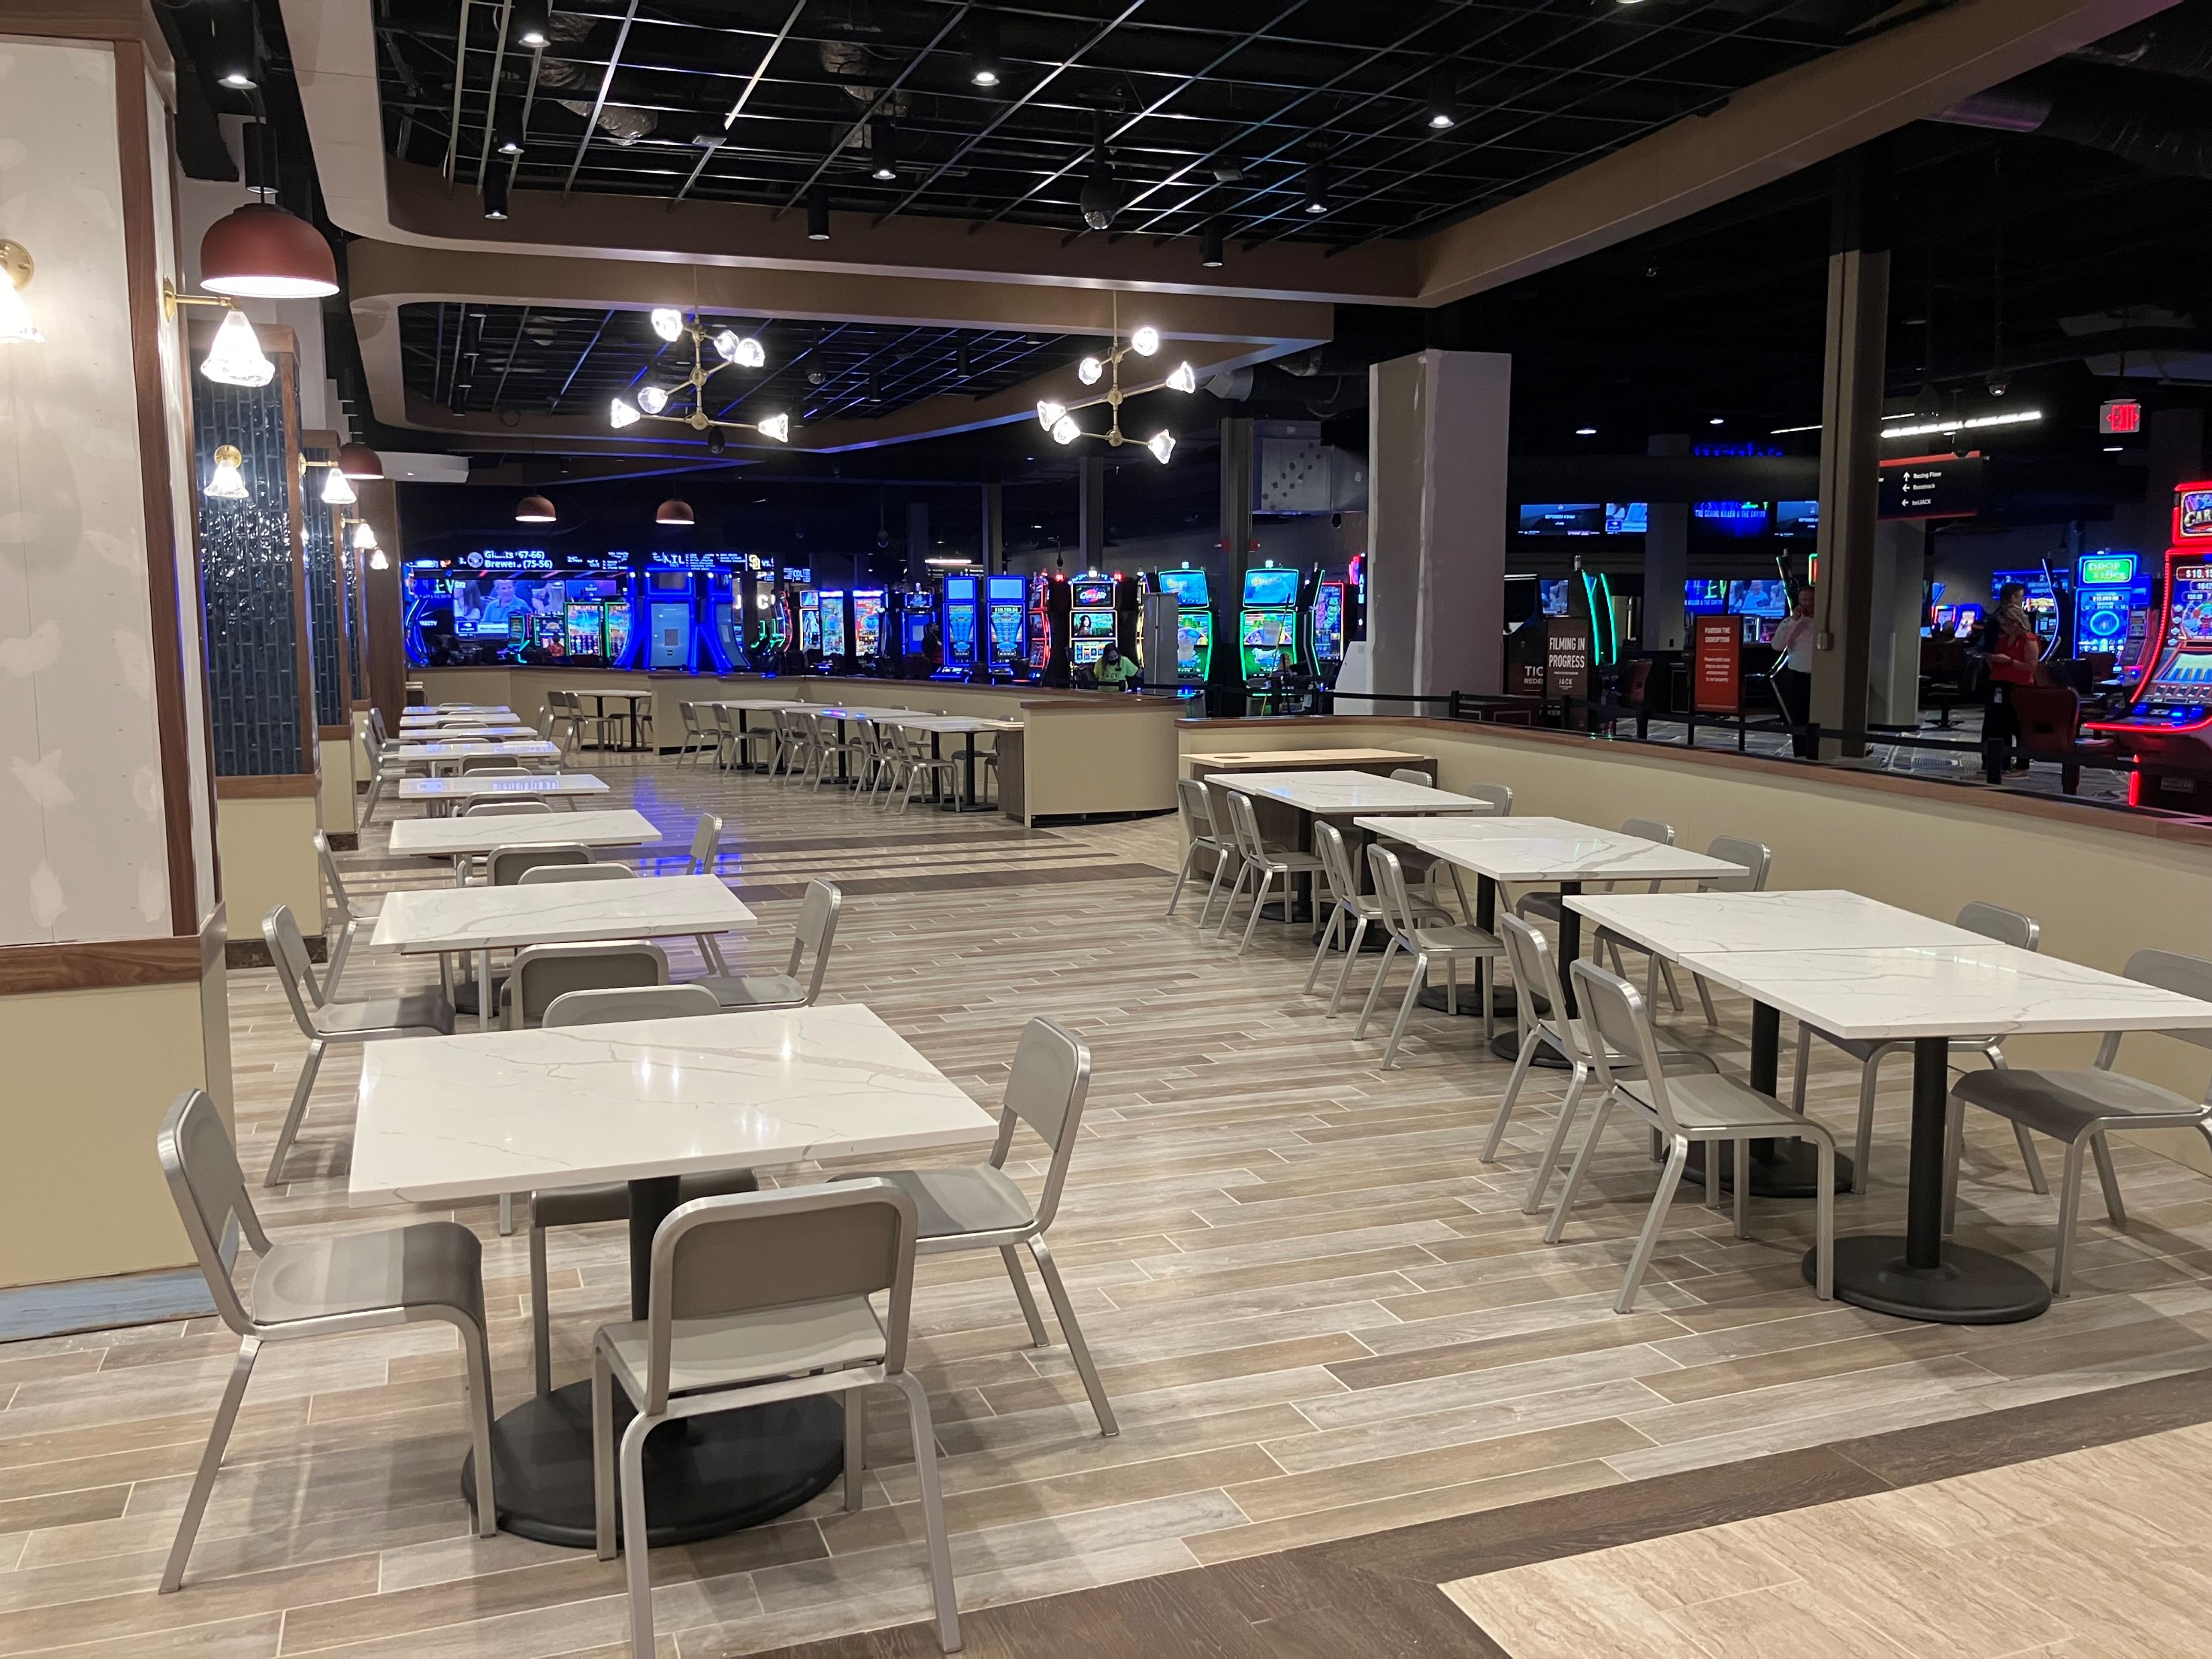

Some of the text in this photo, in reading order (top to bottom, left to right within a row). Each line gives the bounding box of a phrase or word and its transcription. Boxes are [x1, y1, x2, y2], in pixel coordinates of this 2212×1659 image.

[2111, 405, 2136, 430] EXIT
[2185, 509, 2212, 527] CAR
[2089, 563, 2120, 572] DROP
[1549, 637, 1585, 650] FILMING IN
[1548, 654, 1585, 668] PROGRESS
[1524, 666, 1543, 676] TIC
